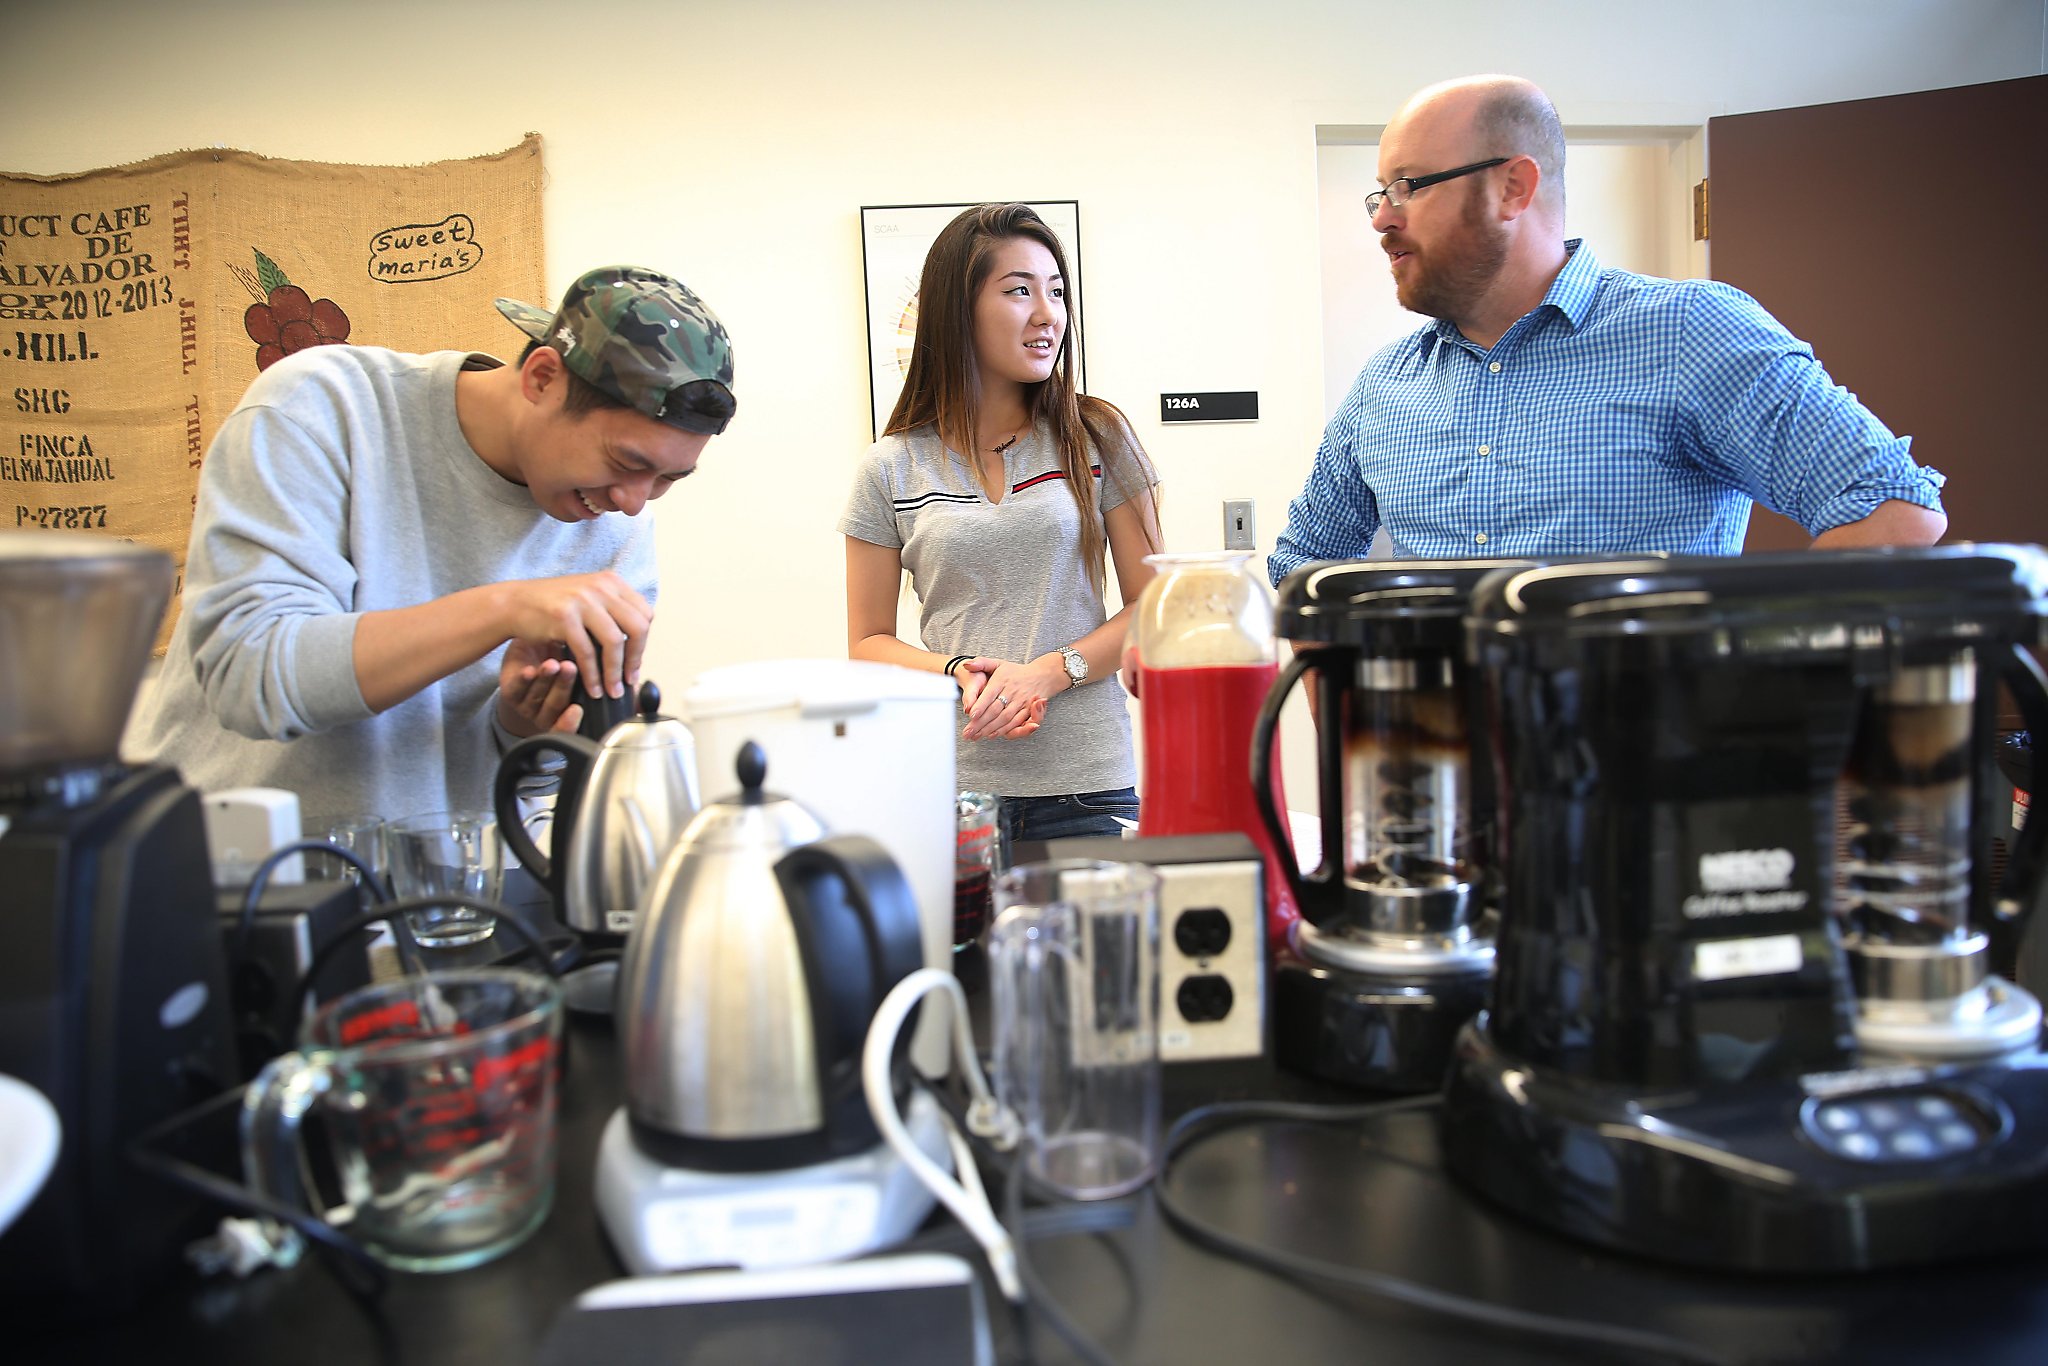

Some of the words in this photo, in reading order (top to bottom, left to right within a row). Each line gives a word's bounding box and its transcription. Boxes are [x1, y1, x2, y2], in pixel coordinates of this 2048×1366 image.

[71, 204, 151, 235] CAFE
[873, 224, 899, 234] SCAA
[85, 232, 133, 259] DE
[377, 221, 466, 251] sweet
[378, 248, 470, 275] maria's
[178, 297, 197, 375] J.HILL
[14, 388, 70, 413] SHG
[1165, 398, 1200, 409] 126A
[20, 434, 94, 457] FINCA
[16, 505, 107, 529] P-27877
